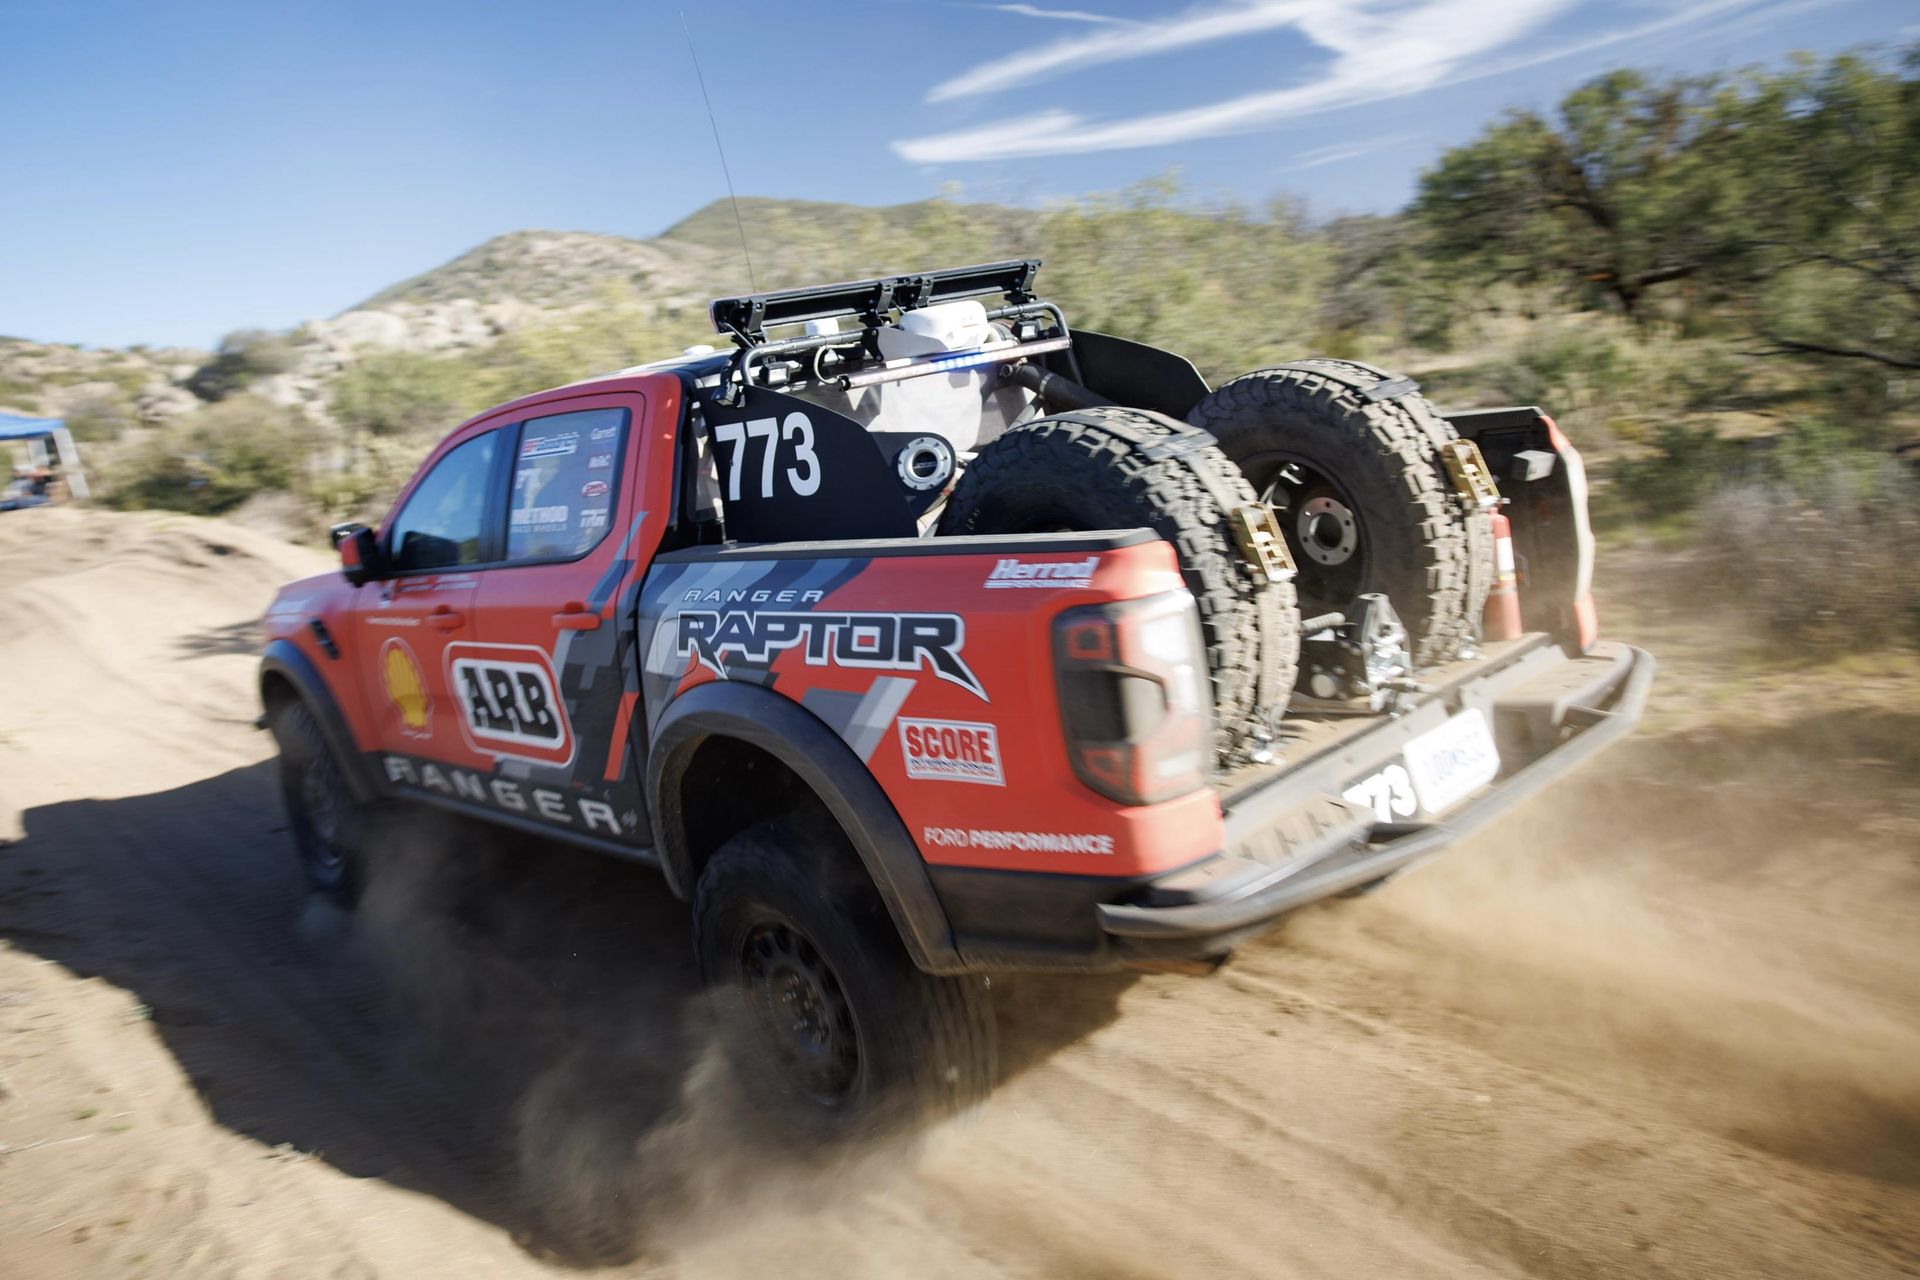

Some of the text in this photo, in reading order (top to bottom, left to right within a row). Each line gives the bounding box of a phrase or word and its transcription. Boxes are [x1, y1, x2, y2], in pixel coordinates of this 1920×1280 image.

[715, 411, 821, 501] 773
[988, 556, 1100, 579] Herrod
[683, 590, 824, 602] RANGER
[676, 610, 991, 703] RAPTOR
[460, 666, 559, 740] ARB
[906, 725, 993, 764] SCORE
[383, 755, 622, 836] RANGER
[924, 826, 1114, 855] FORD PERFORMANCE
